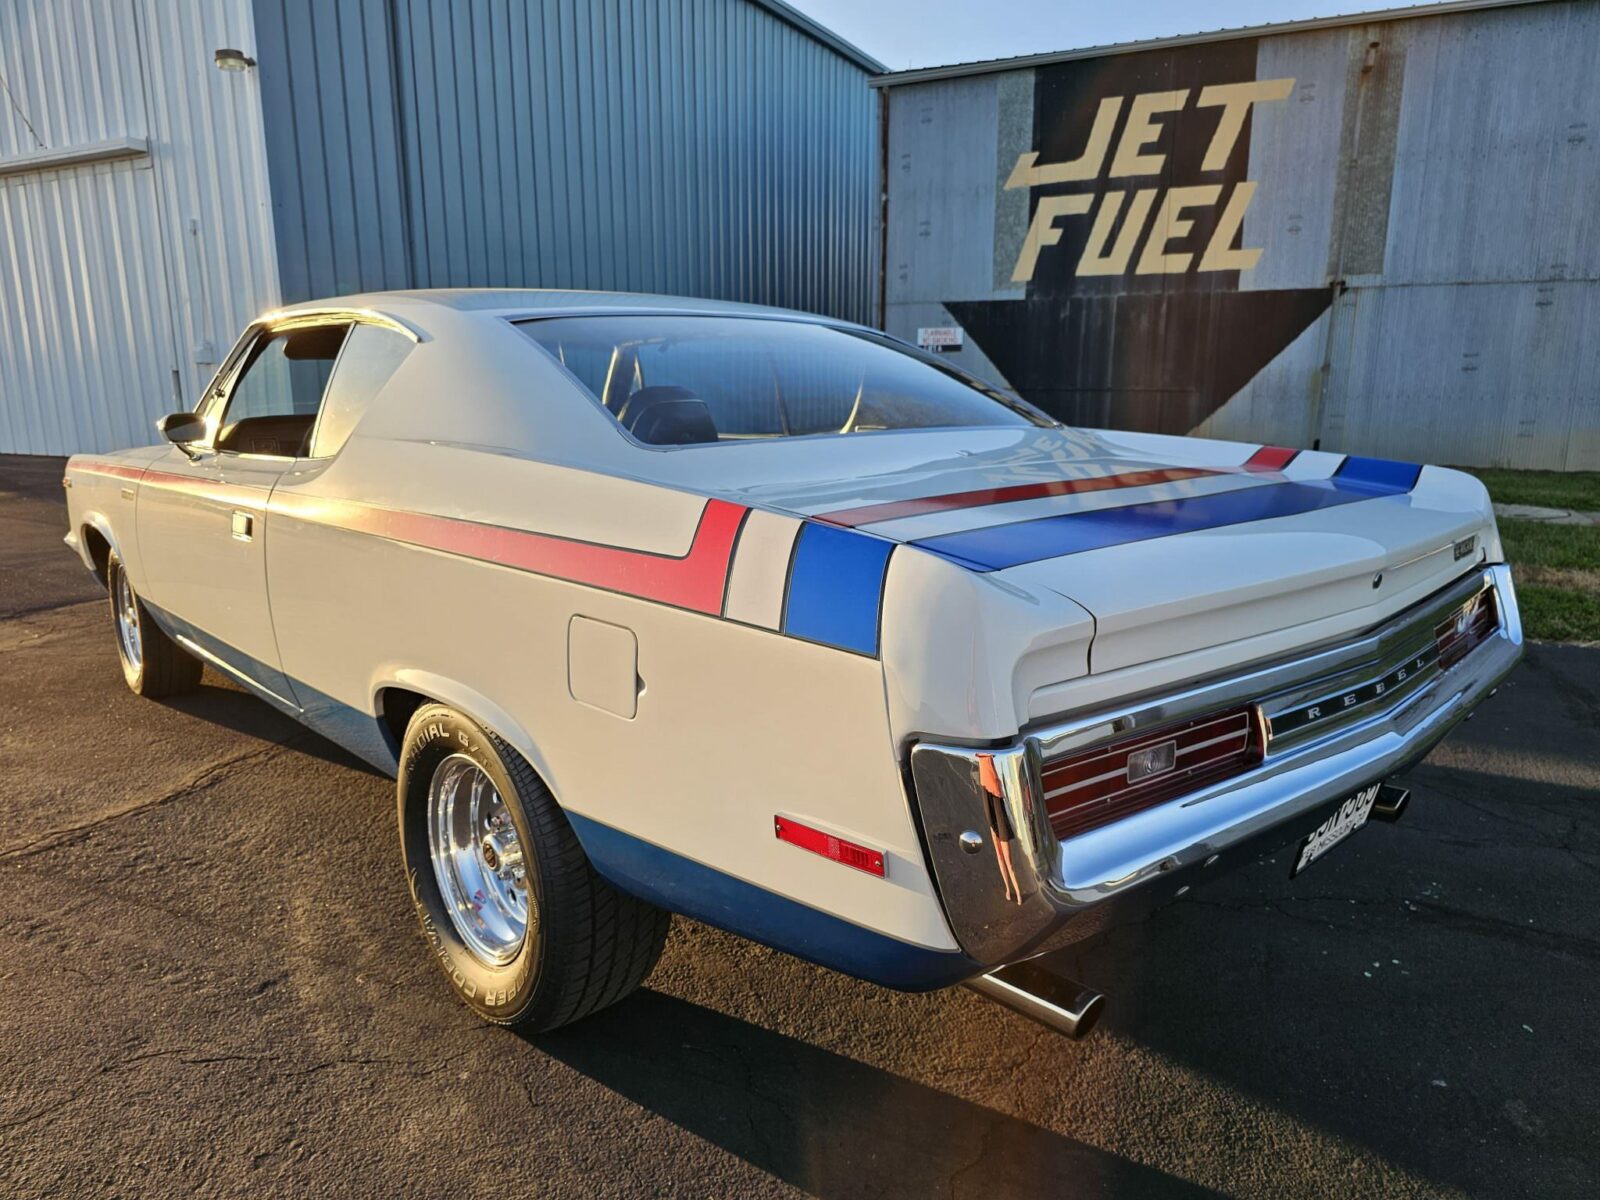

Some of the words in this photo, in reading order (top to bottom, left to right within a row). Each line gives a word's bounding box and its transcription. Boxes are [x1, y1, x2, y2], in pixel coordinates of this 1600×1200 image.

[1003, 78, 1296, 190] JET
[1010, 181, 1264, 282] FUEL
[1307, 658, 1424, 719] REBEL
